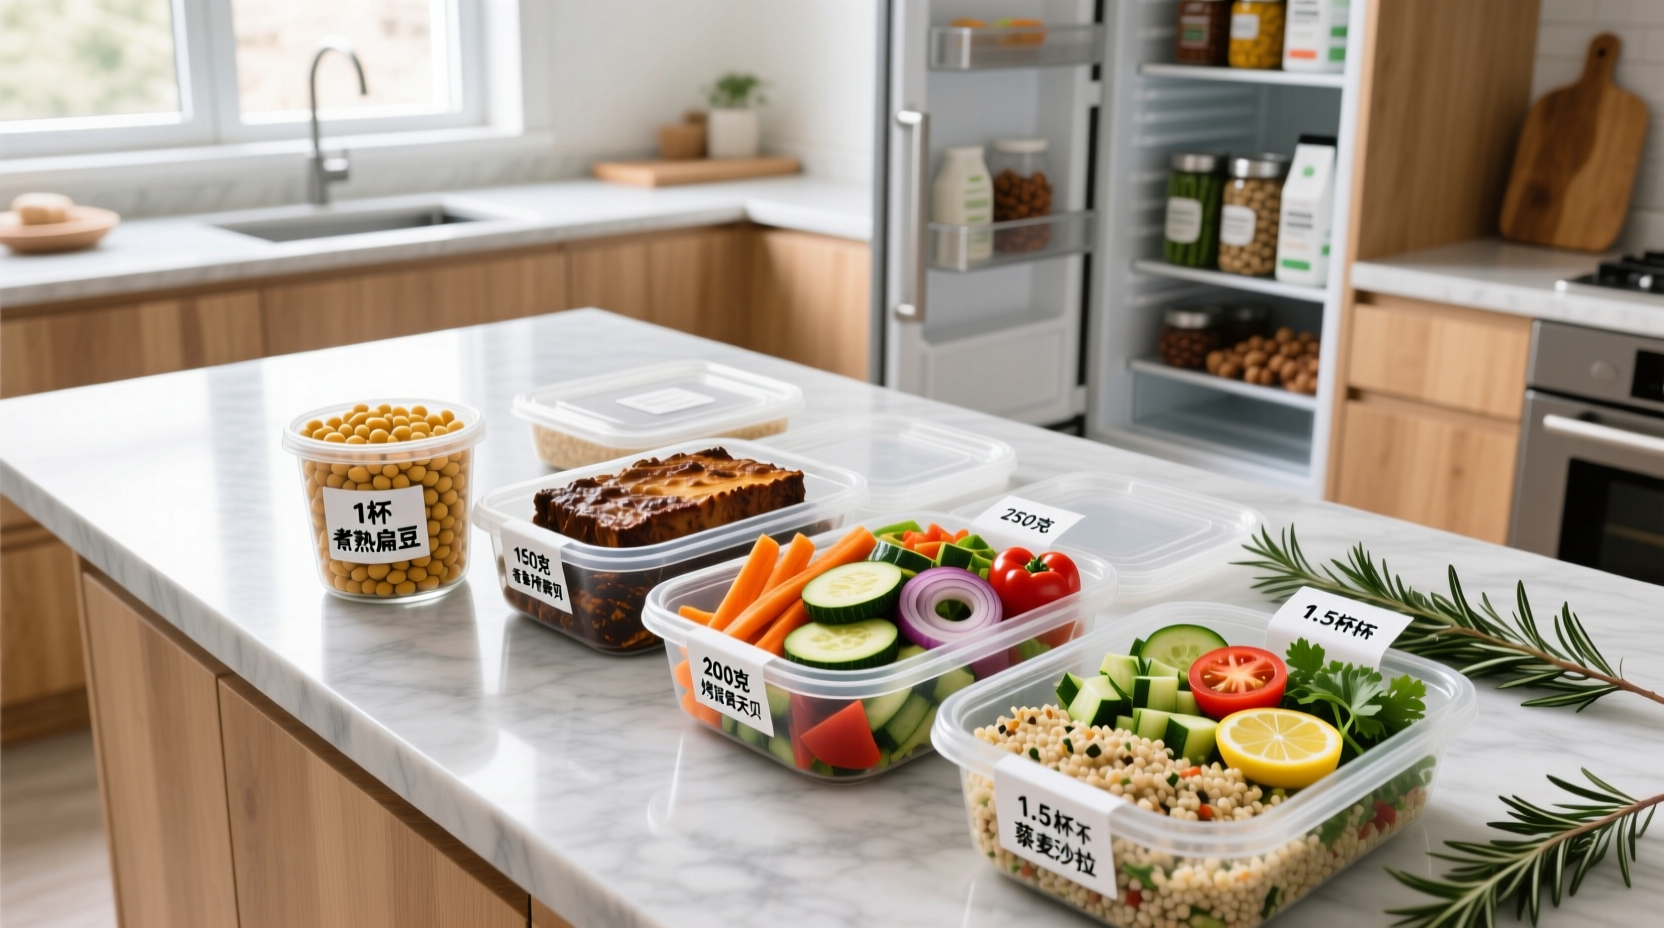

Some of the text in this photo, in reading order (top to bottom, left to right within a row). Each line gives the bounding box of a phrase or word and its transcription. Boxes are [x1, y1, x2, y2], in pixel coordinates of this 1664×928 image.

[353, 500, 392, 525] 1杯
[1000, 508, 1055, 533] 250克
[513, 546, 551, 576] 150克
[703, 656, 750, 693] 200克
[1014, 821, 1097, 878] 藜麦沙拉
